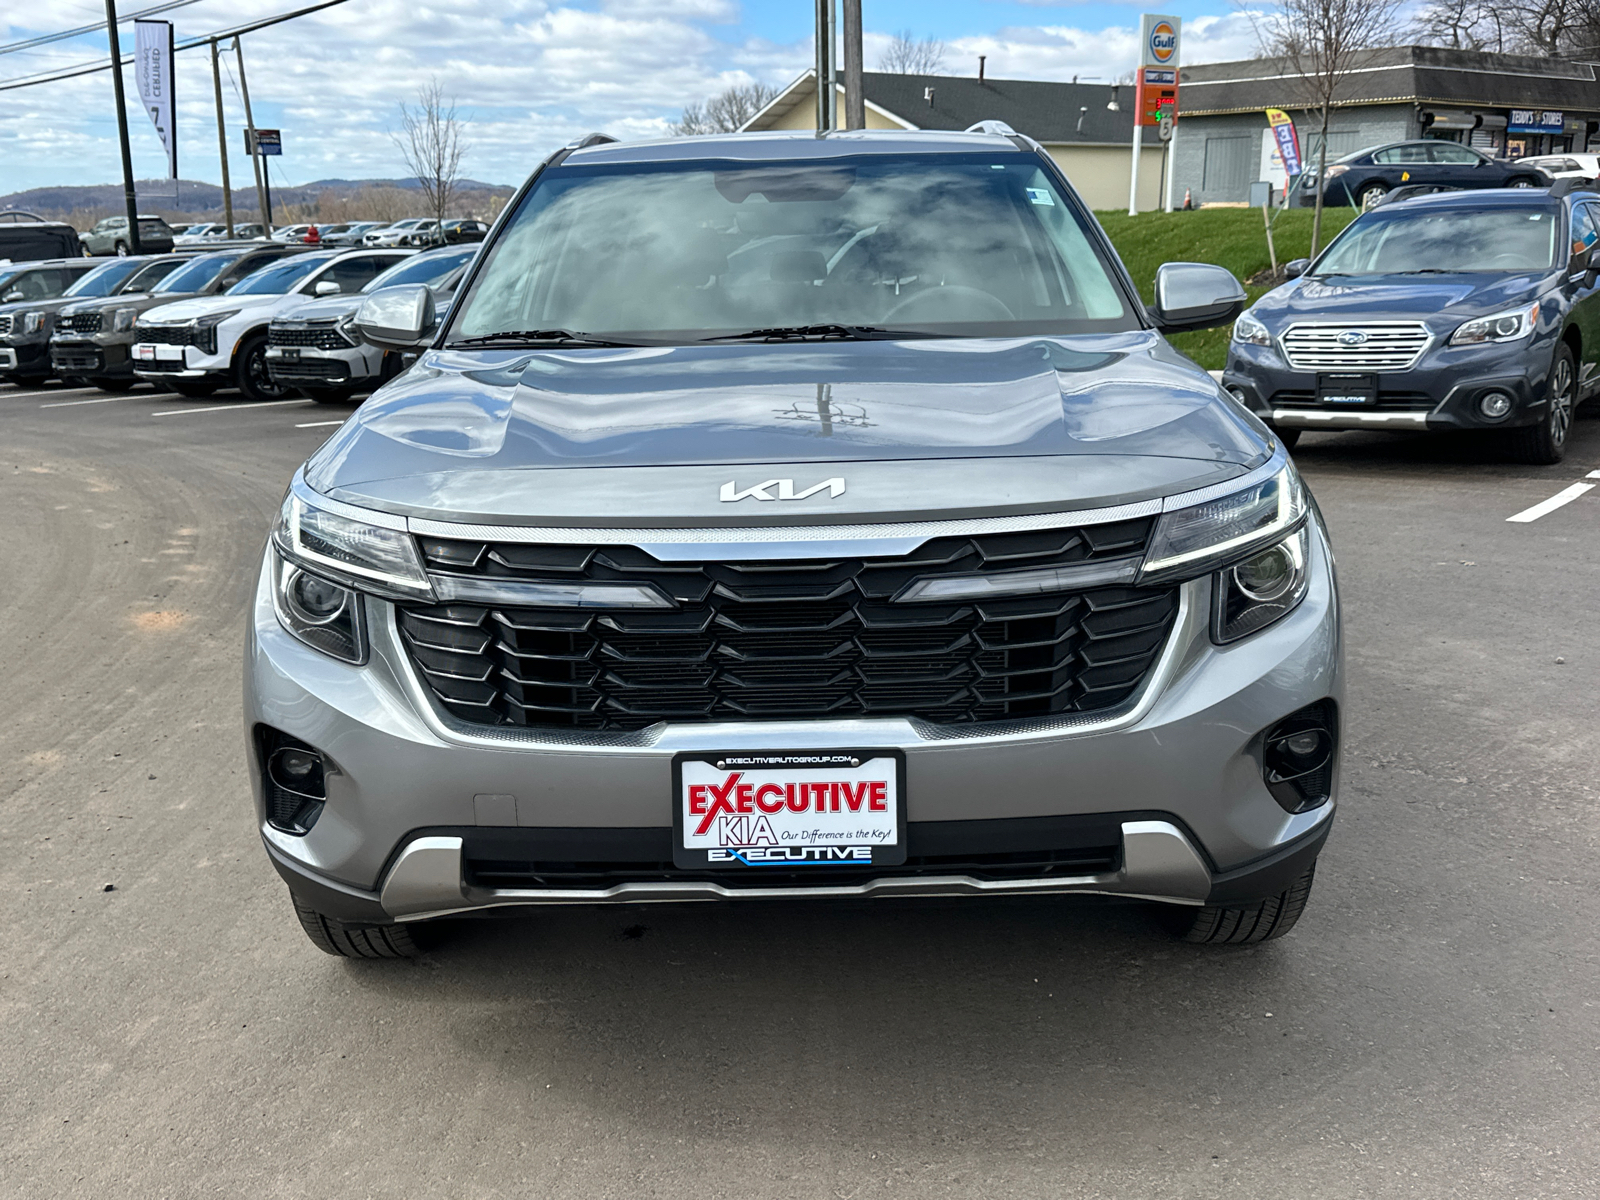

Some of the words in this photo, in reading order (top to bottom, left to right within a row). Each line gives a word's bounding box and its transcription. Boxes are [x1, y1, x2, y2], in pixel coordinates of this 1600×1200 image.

[1153, 35, 1175, 48] Gulf
[1512, 110, 1533, 124] TEDDY'S
[1542, 112, 1562, 125] STORES
[719, 477, 846, 502] KIA
[725, 756, 852, 765] EXECUTIVEAUTOGROUP.COM
[688, 772, 888, 836] EXECUTIVE
[718, 815, 779, 846] KIA
[781, 830, 799, 840] Our
[801, 829, 845, 844] Difference
[846, 830, 853, 839] is
[855, 829, 870, 839] the
[871, 829, 892, 843] Key!
[707, 846, 873, 866] EXECUTIVE
